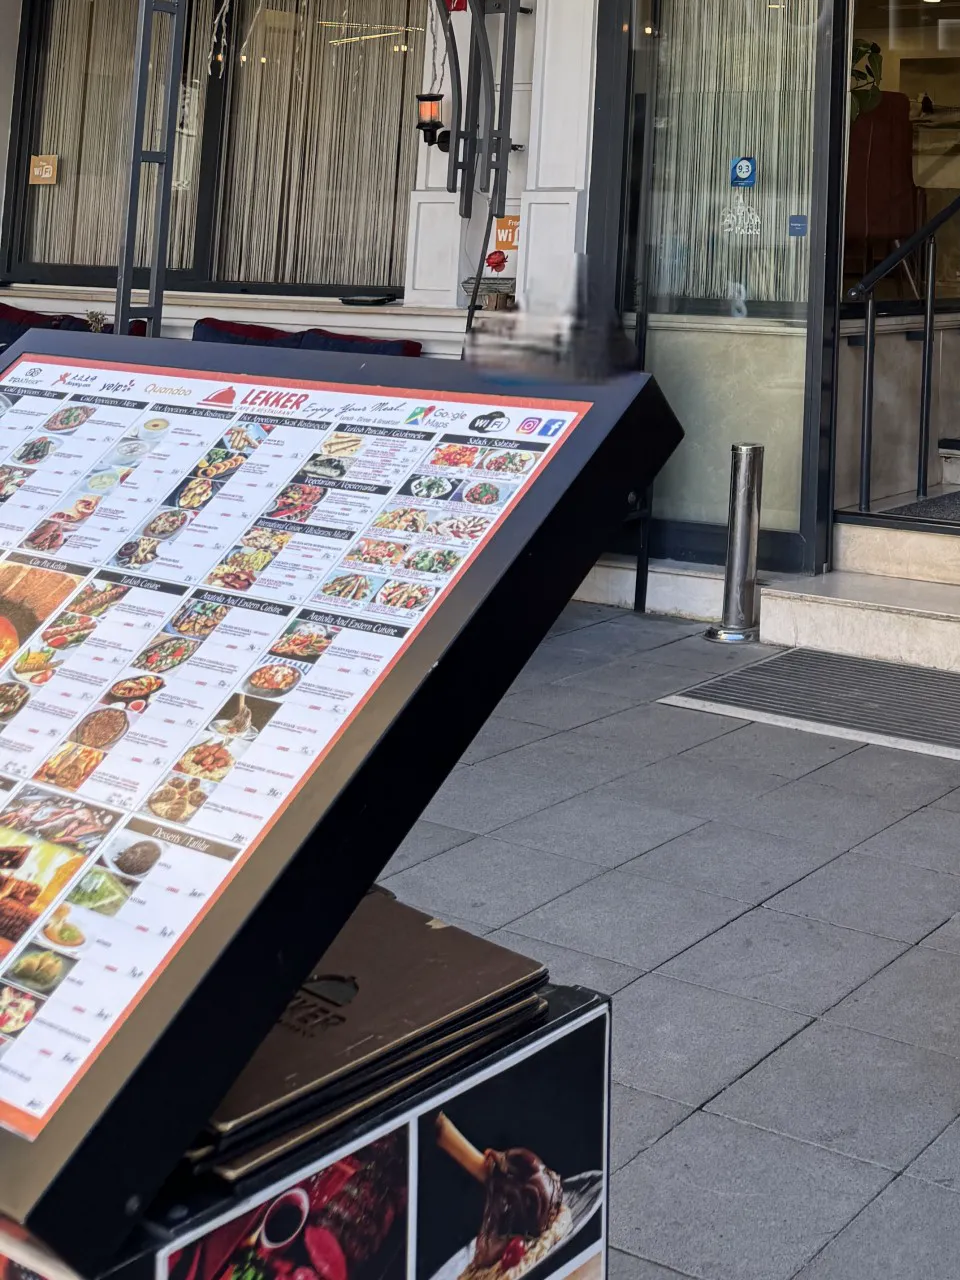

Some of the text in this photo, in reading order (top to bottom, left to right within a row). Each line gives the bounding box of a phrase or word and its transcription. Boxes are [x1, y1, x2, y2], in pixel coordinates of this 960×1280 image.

[98, 382, 123, 397] yelp
[143, 383, 193, 397] Quandoo
[239, 388, 310, 411] LEKKER
[302, 402, 336, 418] Enjoy
[424, 419, 450, 429] Maps
[119, 576, 162, 590] Turkish Cuisine
[200, 591, 226, 602] Anatolia
[237, 598, 262, 609] Eastern
[259, 602, 284, 614] Cuisine
[306, 611, 335, 623] Anatolia
[347, 619, 373, 631] Eastern
[371, 623, 398, 635] Cuisine
[152, 826, 183, 843] Desserts
